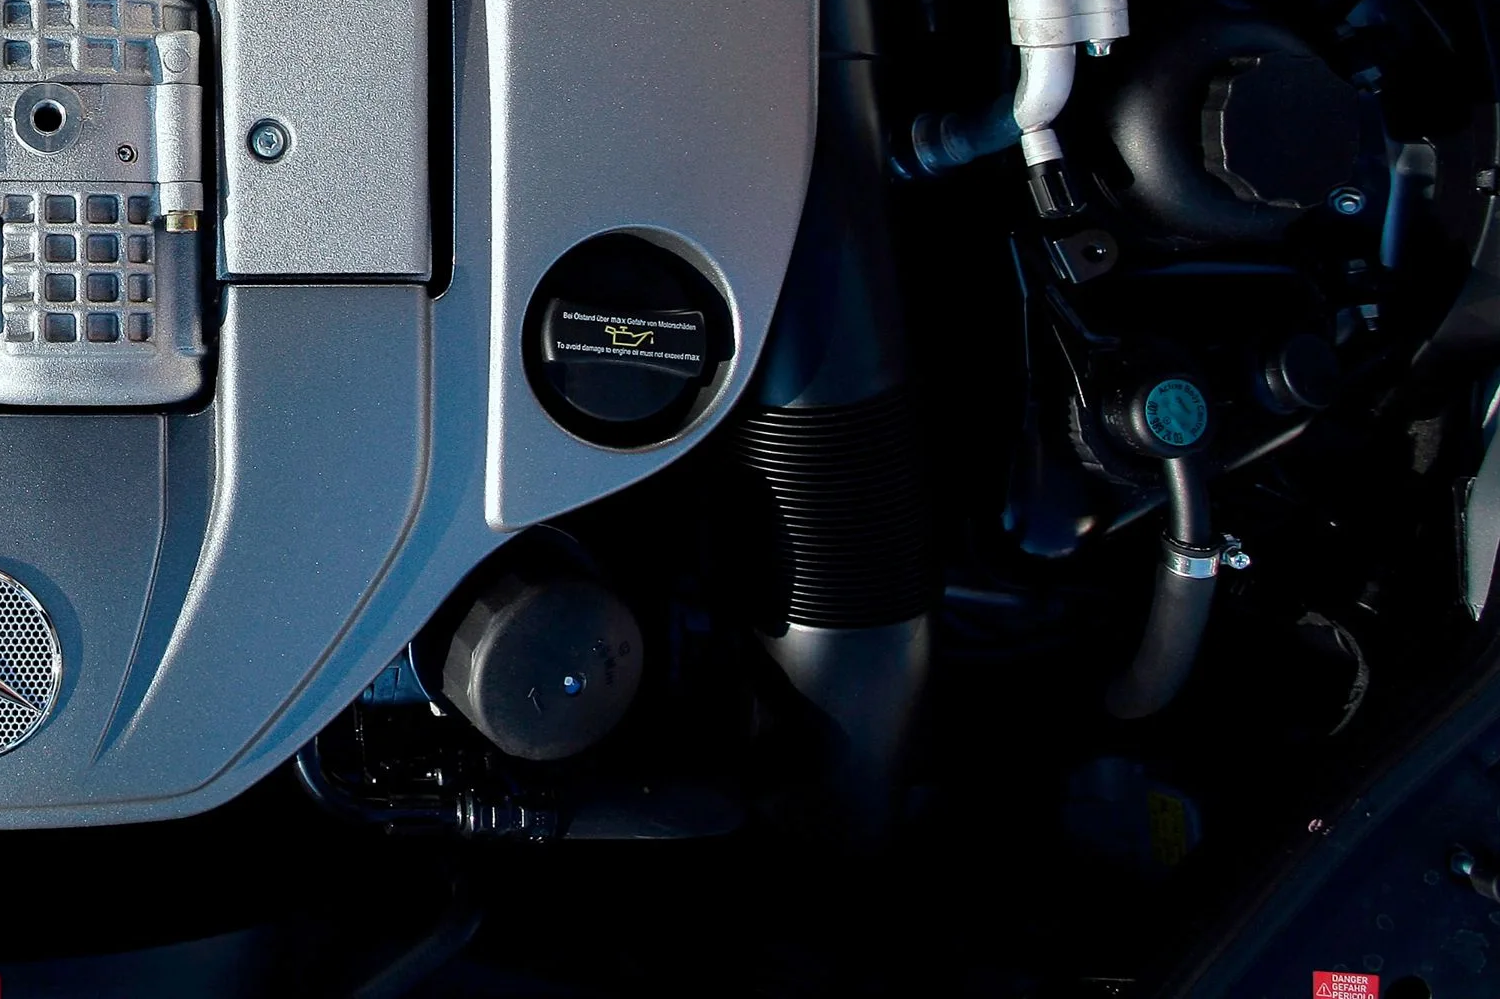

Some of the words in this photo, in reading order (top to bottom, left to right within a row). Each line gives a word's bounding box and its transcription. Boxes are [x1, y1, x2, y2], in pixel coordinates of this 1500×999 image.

[562, 311, 573, 320] Bei
[610, 315, 627, 324] max
[627, 317, 646, 327] Gefahr
[556, 341, 565, 349] To
[565, 342, 581, 351] avoid
[581, 343, 605, 354] damage
[612, 347, 632, 356] engine
[639, 349, 654, 357] must
[654, 350, 664, 358] not
[664, 351, 684, 360] exceed
[684, 352, 700, 362] max
[1331, 974, 1369, 985] DANGER
[1331, 982, 1368, 993] GEFAHR
[1331, 991, 1375, 999] PERICOLO
